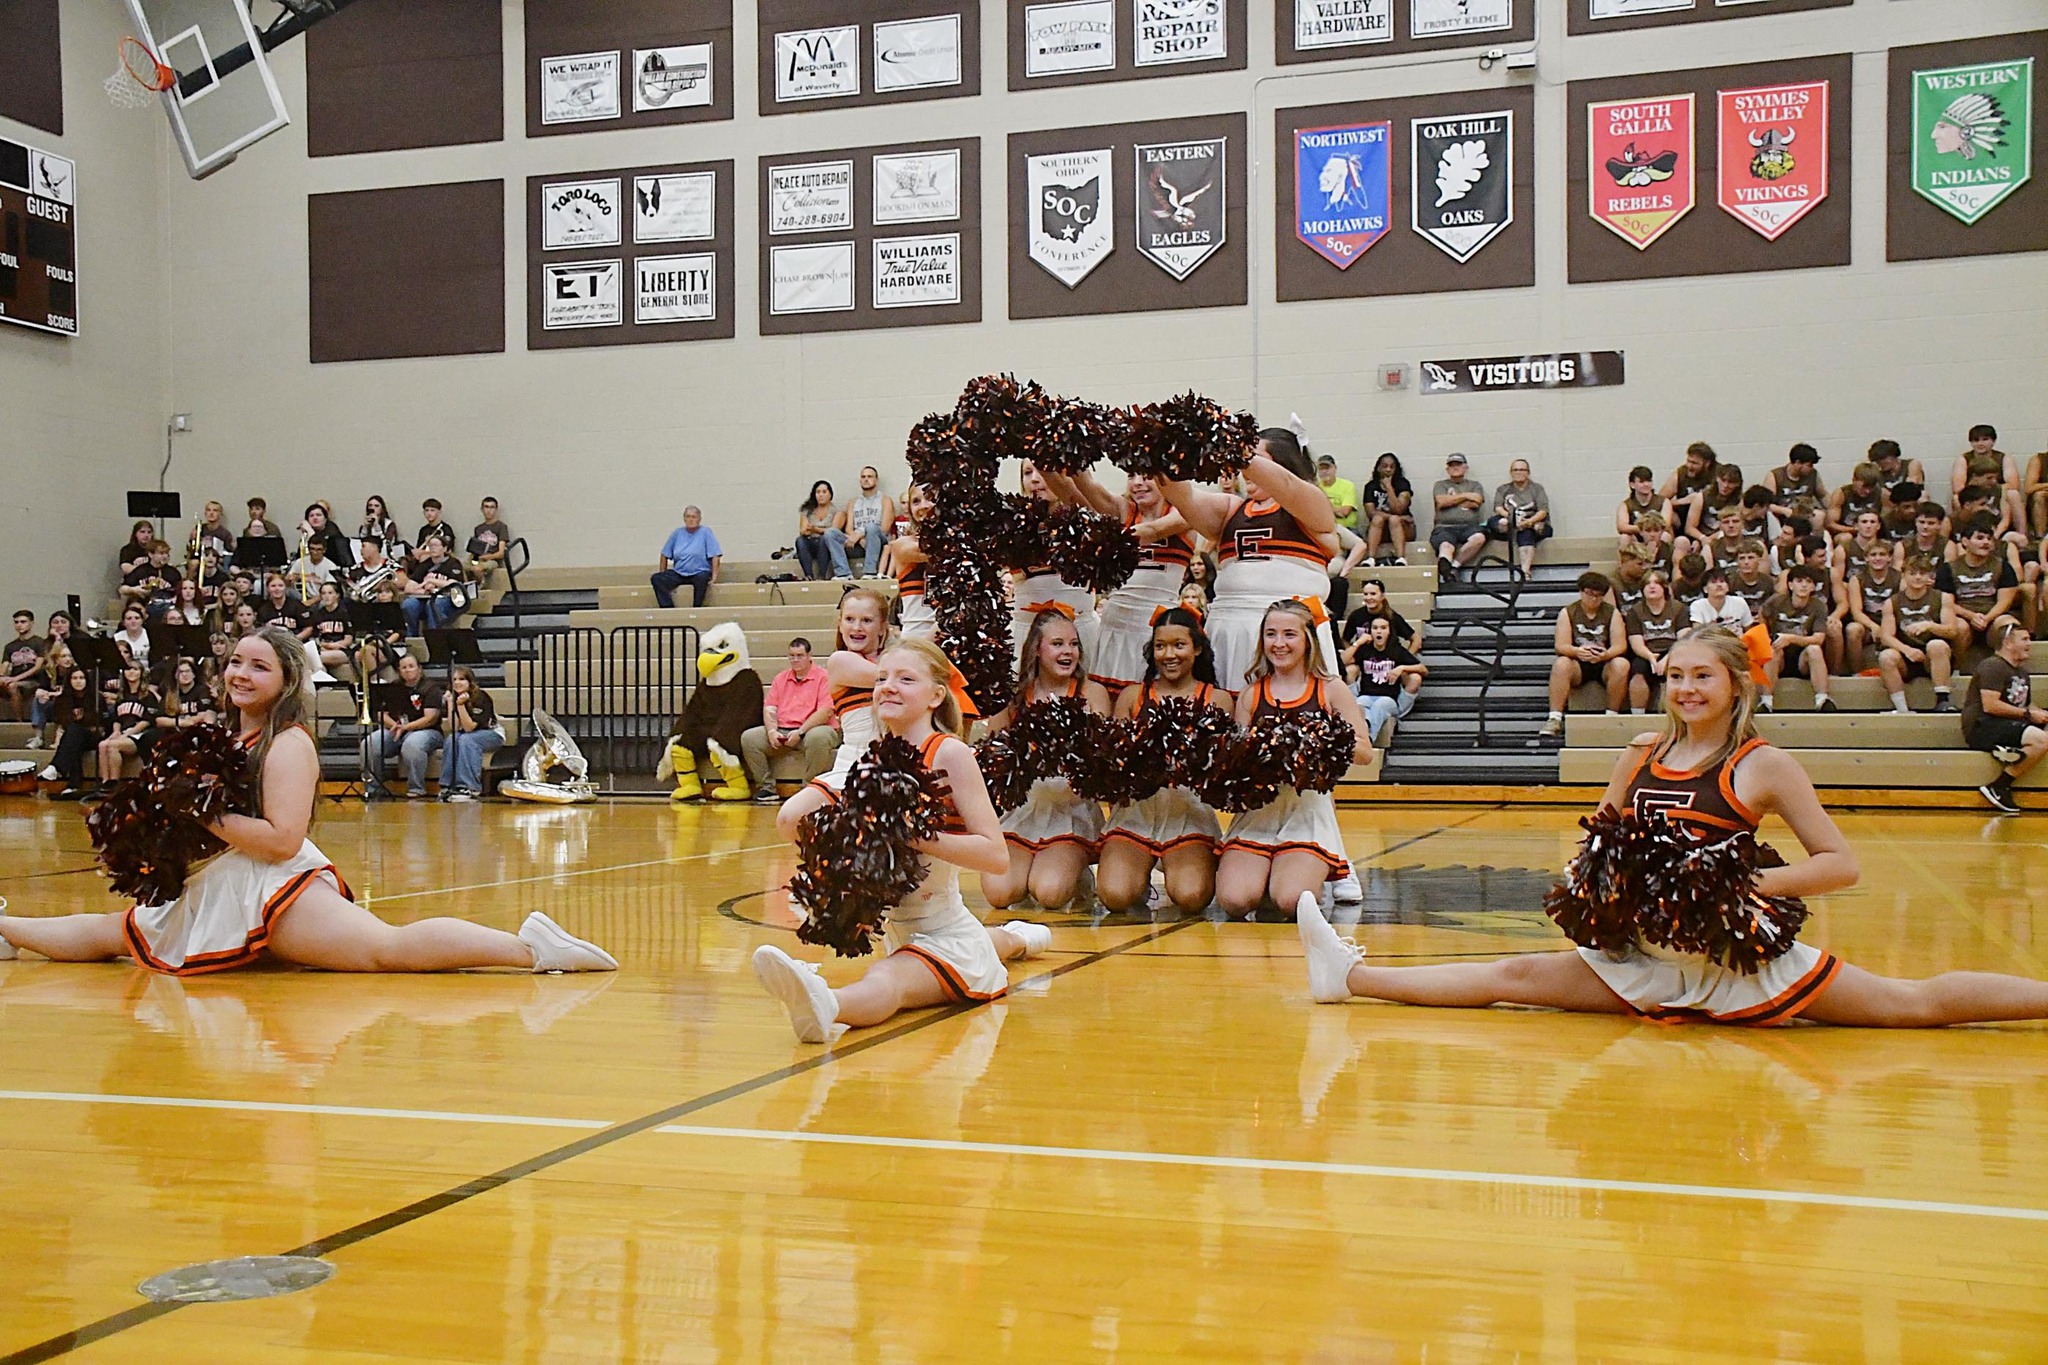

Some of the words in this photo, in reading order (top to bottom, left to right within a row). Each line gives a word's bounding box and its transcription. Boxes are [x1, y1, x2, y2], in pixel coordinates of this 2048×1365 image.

[1316, 0, 1371, 17] VALLEY
[1069, 20, 1112, 34] PATH
[1142, 20, 1218, 40] REPAIR
[1303, 14, 1386, 36] HARDWARE
[1423, 18, 1461, 30] FROSTY
[1465, 14, 1498, 25] KREME
[1153, 36, 1208, 54] SHOP
[549, 65, 566, 74] WE
[570, 62, 600, 72] WRAP
[604, 60, 612, 69] IT
[1925, 67, 2020, 90] WESTERN
[1735, 90, 1810, 110] SYMMES
[1610, 104, 1672, 122] SOUTH
[1738, 106, 1807, 124] VALLEY
[1424, 124, 1458, 140] OAK
[1460, 120, 1501, 136] HILL
[1609, 117, 1673, 136] GALLIA
[1300, 128, 1386, 149] NORTHWEST
[1040, 156, 1099, 168] SOUTHERN
[1146, 144, 1215, 163] EASTERN
[802, 174, 820, 188] AUTO
[822, 171, 848, 186] REPAIR
[1056, 168, 1085, 178] OHIO
[1931, 166, 2012, 186] INDIANS
[551, 188, 582, 213] TORO
[584, 189, 612, 216] LOCO
[1735, 184, 1809, 202] VIKINGS
[1950, 190, 1980, 208] SOC
[26, 196, 68, 224] GUEST
[1044, 190, 1091, 224] SOC
[1608, 195, 1673, 212] REBELS
[1440, 210, 1484, 226] OAKS
[1622, 216, 1650, 234] SOC
[1753, 206, 1780, 226] SOC
[1303, 216, 1384, 235] MOHAWKS
[1034, 234, 1108, 261] CONFERENCE
[1151, 230, 1211, 247] EAGLES
[1326, 236, 1352, 256] SOC
[880, 244, 952, 260] WILLIAMS
[1164, 250, 1189, 267] SOC
[46, 264, 74, 283] FOULS
[882, 260, 911, 276] True
[906, 258, 948, 274] Value
[641, 269, 709, 293] LIBERTY
[880, 274, 952, 288] HARDWARE
[641, 294, 678, 308] GENERAL
[682, 293, 710, 306] STORE
[47, 314, 75, 331] SCORE
[1468, 360, 1576, 386] VISITORS
[1234, 528, 1274, 563] E
